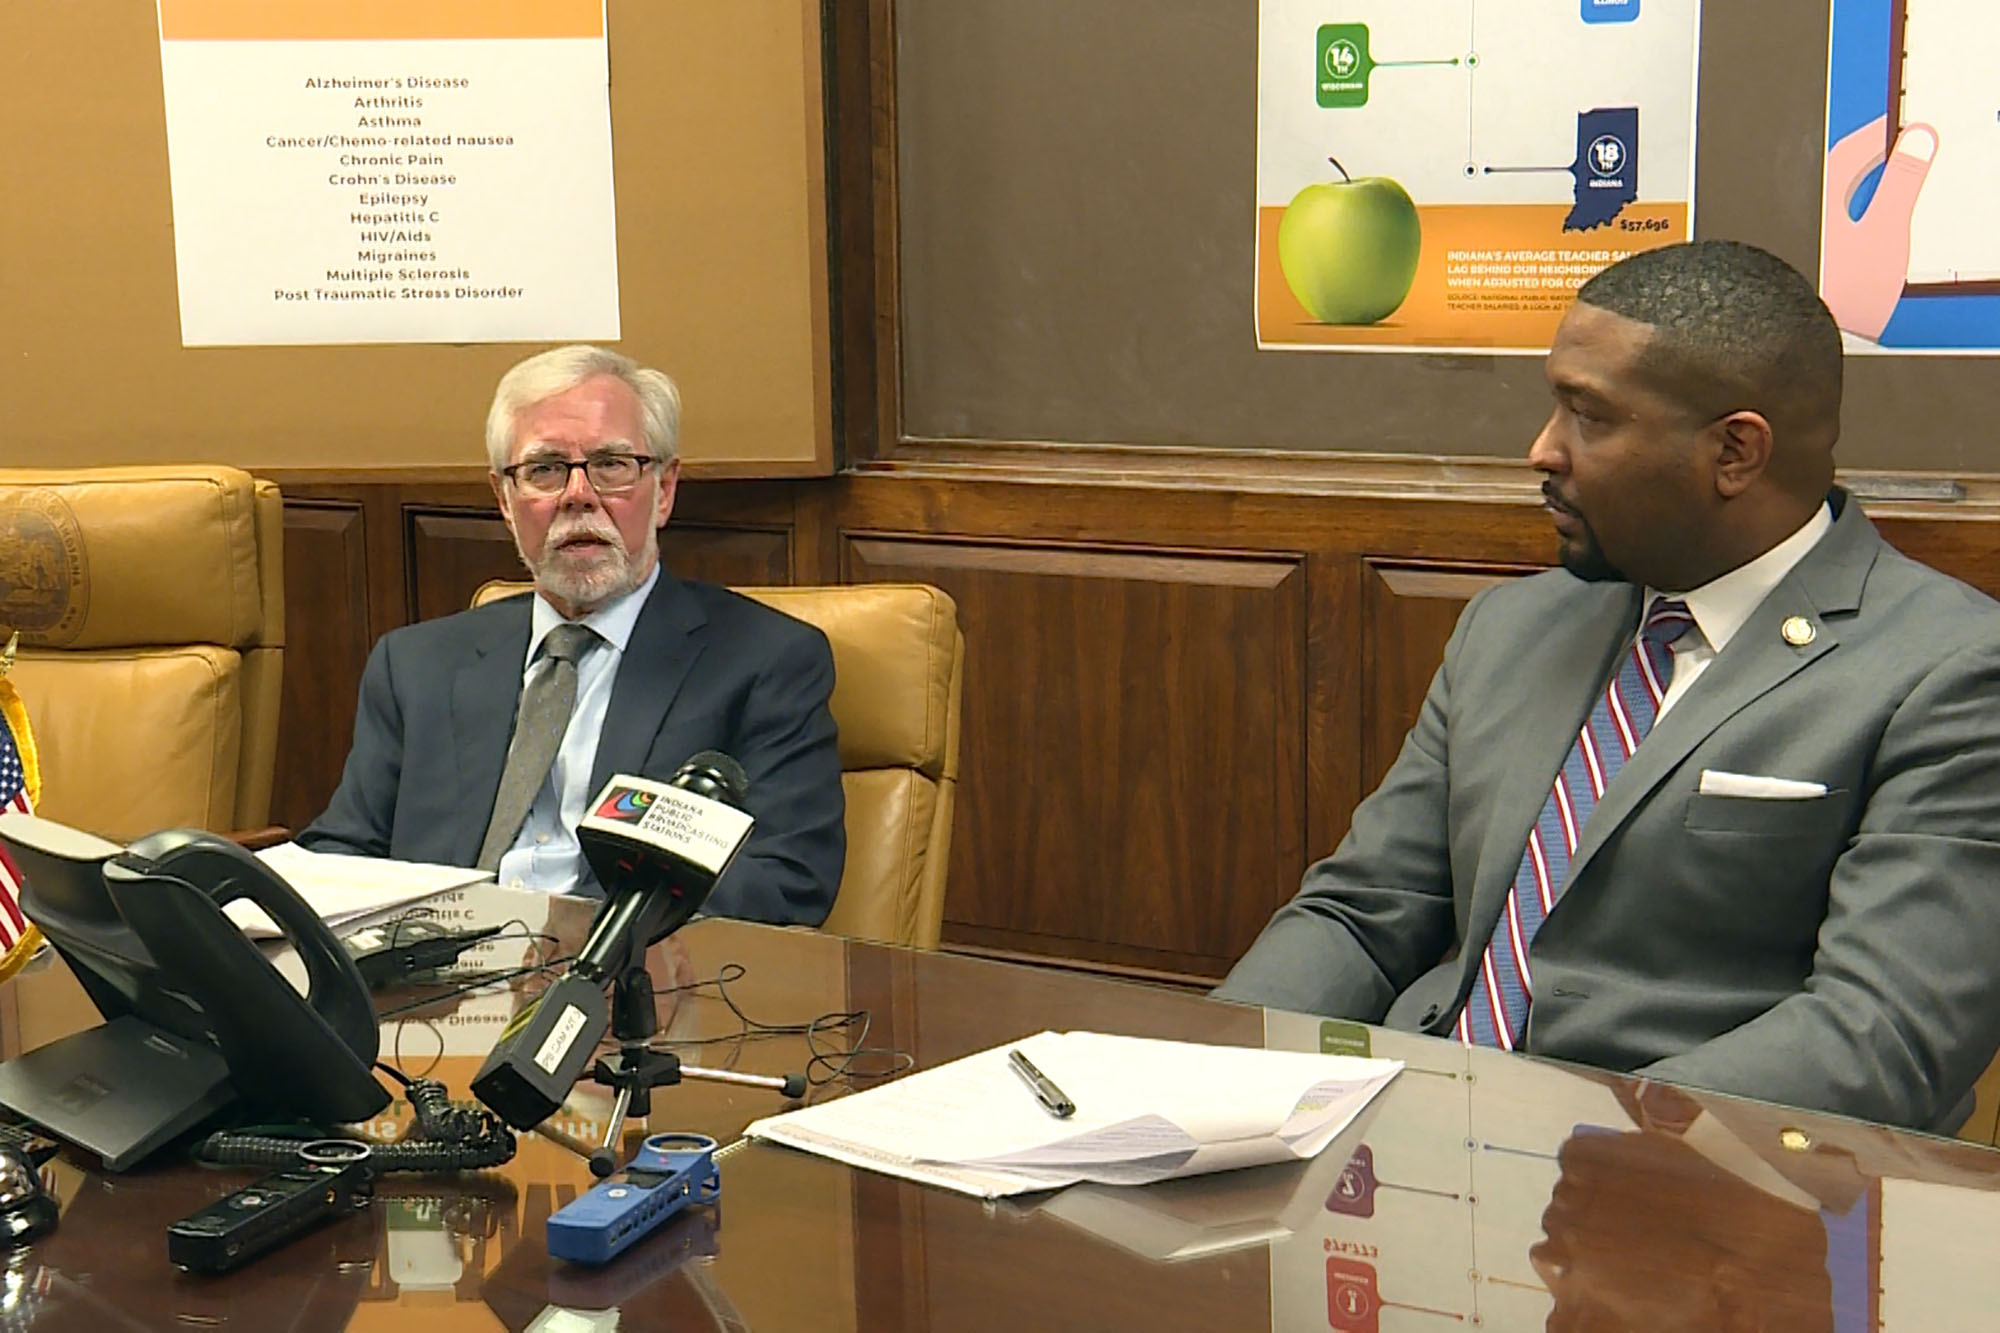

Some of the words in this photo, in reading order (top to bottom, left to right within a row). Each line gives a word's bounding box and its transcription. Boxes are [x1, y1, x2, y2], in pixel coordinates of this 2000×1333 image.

[1331, 47, 1354, 66] 14
[304, 75, 403, 89] Alzheimer's
[406, 75, 470, 89] Disease
[353, 95, 424, 109] Arthritis
[357, 115, 422, 128] Asthma
[265, 133, 452, 149] Cancer/Chemo-related
[456, 135, 514, 146] nausea
[339, 152, 403, 167] Chronic
[407, 152, 444, 166] Pain
[1595, 142, 1619, 161] 18
[328, 172, 391, 186] Crohn's
[394, 171, 457, 186] Disease
[359, 191, 429, 208] Epilepsy
[350, 210, 425, 227] Hepatitis
[428, 210, 440, 224] C
[1620, 218, 1669, 232] $57,696
[360, 229, 432, 245] HIV/Aids
[357, 248, 437, 265] Migraines
[1447, 251, 1501, 261] INDIANA'S
[1504, 251, 1556, 261] AVERAGE
[1558, 251, 1610, 261] TEACHER
[326, 268, 394, 284] Multiple
[397, 267, 470, 282] Sclerosis
[1470, 265, 1511, 274] BEHIND
[1513, 265, 1537, 274] OUR
[1447, 278, 1480, 288] WHEN
[1483, 278, 1539, 288] ADJUSTED
[1541, 278, 1564, 288] FOR
[274, 289, 310, 302] Post
[313, 286, 397, 301] Traumatic
[400, 287, 451, 300] Stress
[454, 285, 524, 299] Disorder
[654, 804, 693, 822] PUBLIC
[660, 796, 703, 816] INDIANA
[642, 821, 691, 844] STATIONS
